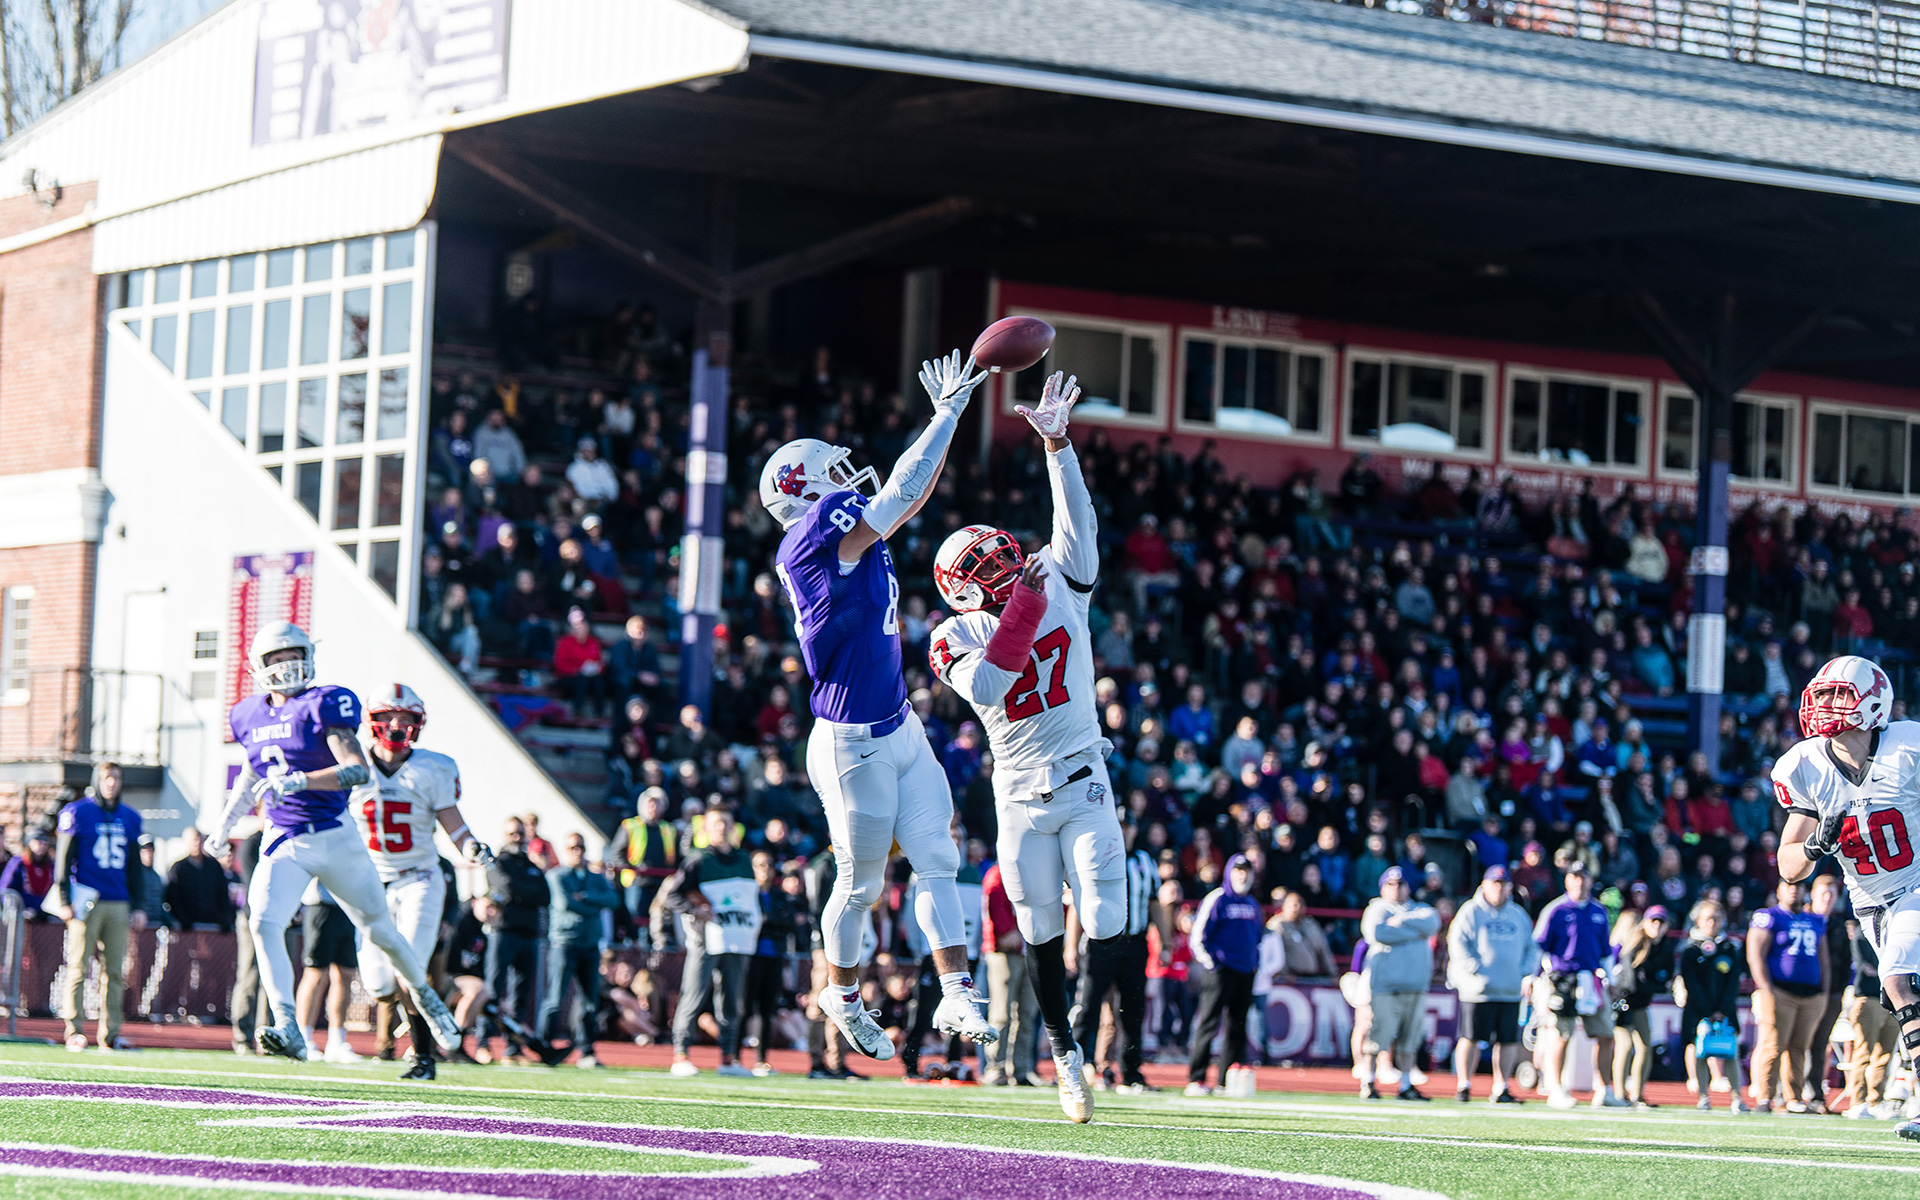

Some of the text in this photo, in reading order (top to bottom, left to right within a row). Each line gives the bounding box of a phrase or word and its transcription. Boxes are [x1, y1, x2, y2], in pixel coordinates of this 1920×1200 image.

[1213, 305, 1266, 331] LSN
[829, 496, 864, 533] 87
[882, 572, 899, 635] 8
[1005, 626, 1071, 723] 27
[338, 694, 354, 718] 2
[260, 744, 289, 779] 2
[1849, 797, 1872, 808] PACIFIC
[362, 800, 413, 853] 15
[1837, 807, 1914, 875] 40
[92, 834, 128, 870] 45
[1787, 929, 1817, 957] 79
